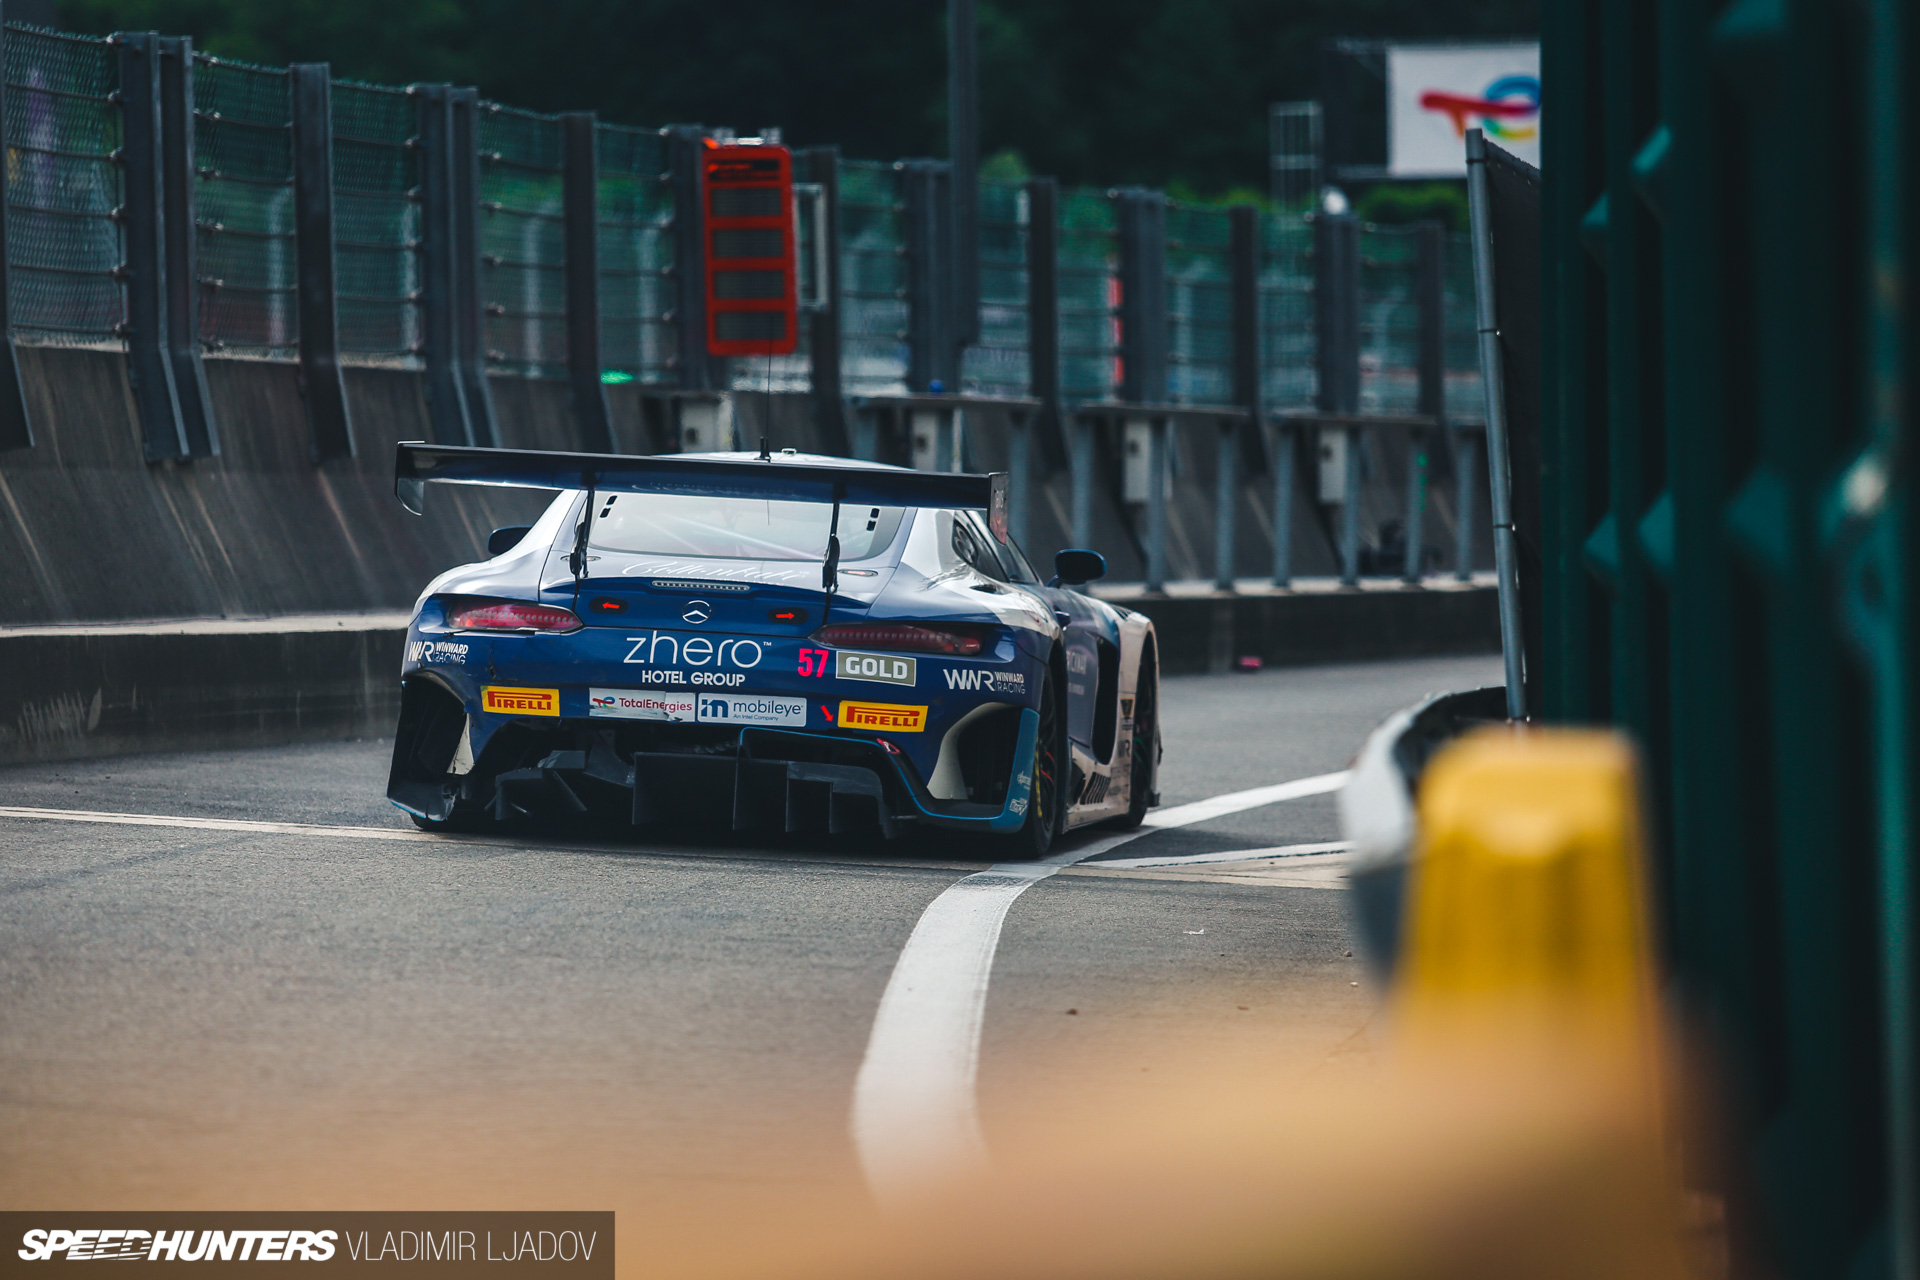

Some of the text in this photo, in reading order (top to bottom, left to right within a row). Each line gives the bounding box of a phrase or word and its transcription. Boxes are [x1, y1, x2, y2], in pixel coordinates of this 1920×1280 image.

[436, 641, 469, 655] WINWARD
[623, 630, 762, 668] zhero
[797, 648, 829, 677] 57
[845, 656, 908, 680] GOLD
[642, 670, 746, 687] HOTEL GROUP
[995, 671, 1024, 684] WINWARD
[996, 682, 1026, 694] RACING
[487, 690, 553, 711] PIRELLI
[618, 697, 693, 713] TotalEnergies
[732, 699, 802, 717] mobileye
[846, 705, 920, 727] PIRELLI
